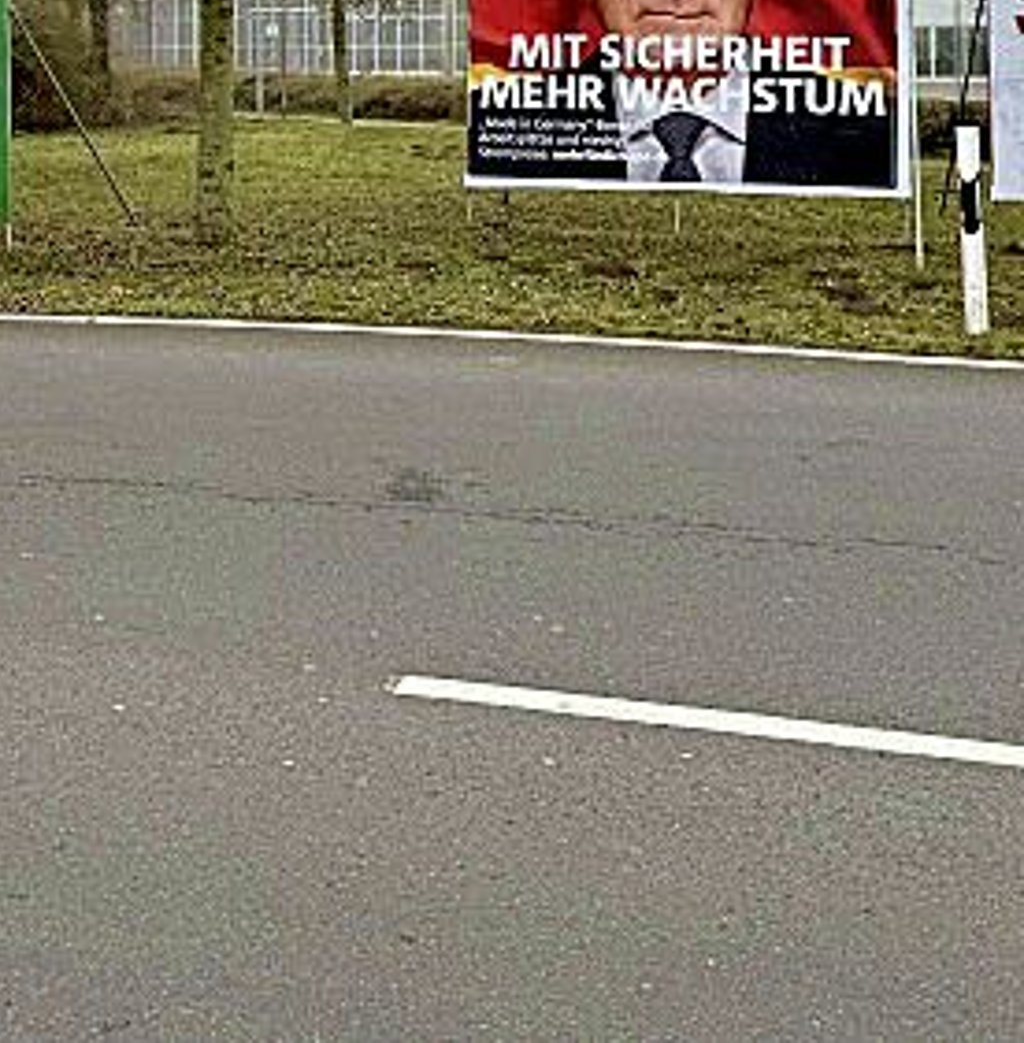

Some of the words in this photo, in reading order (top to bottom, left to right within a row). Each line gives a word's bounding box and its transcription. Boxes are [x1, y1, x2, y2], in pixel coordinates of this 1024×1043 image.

[509, 33, 586, 69] MIT
[600, 33, 851, 72] SICHERHEIT
[478, 74, 606, 110] MEHR
[617, 77, 887, 116] WACHSTUM
